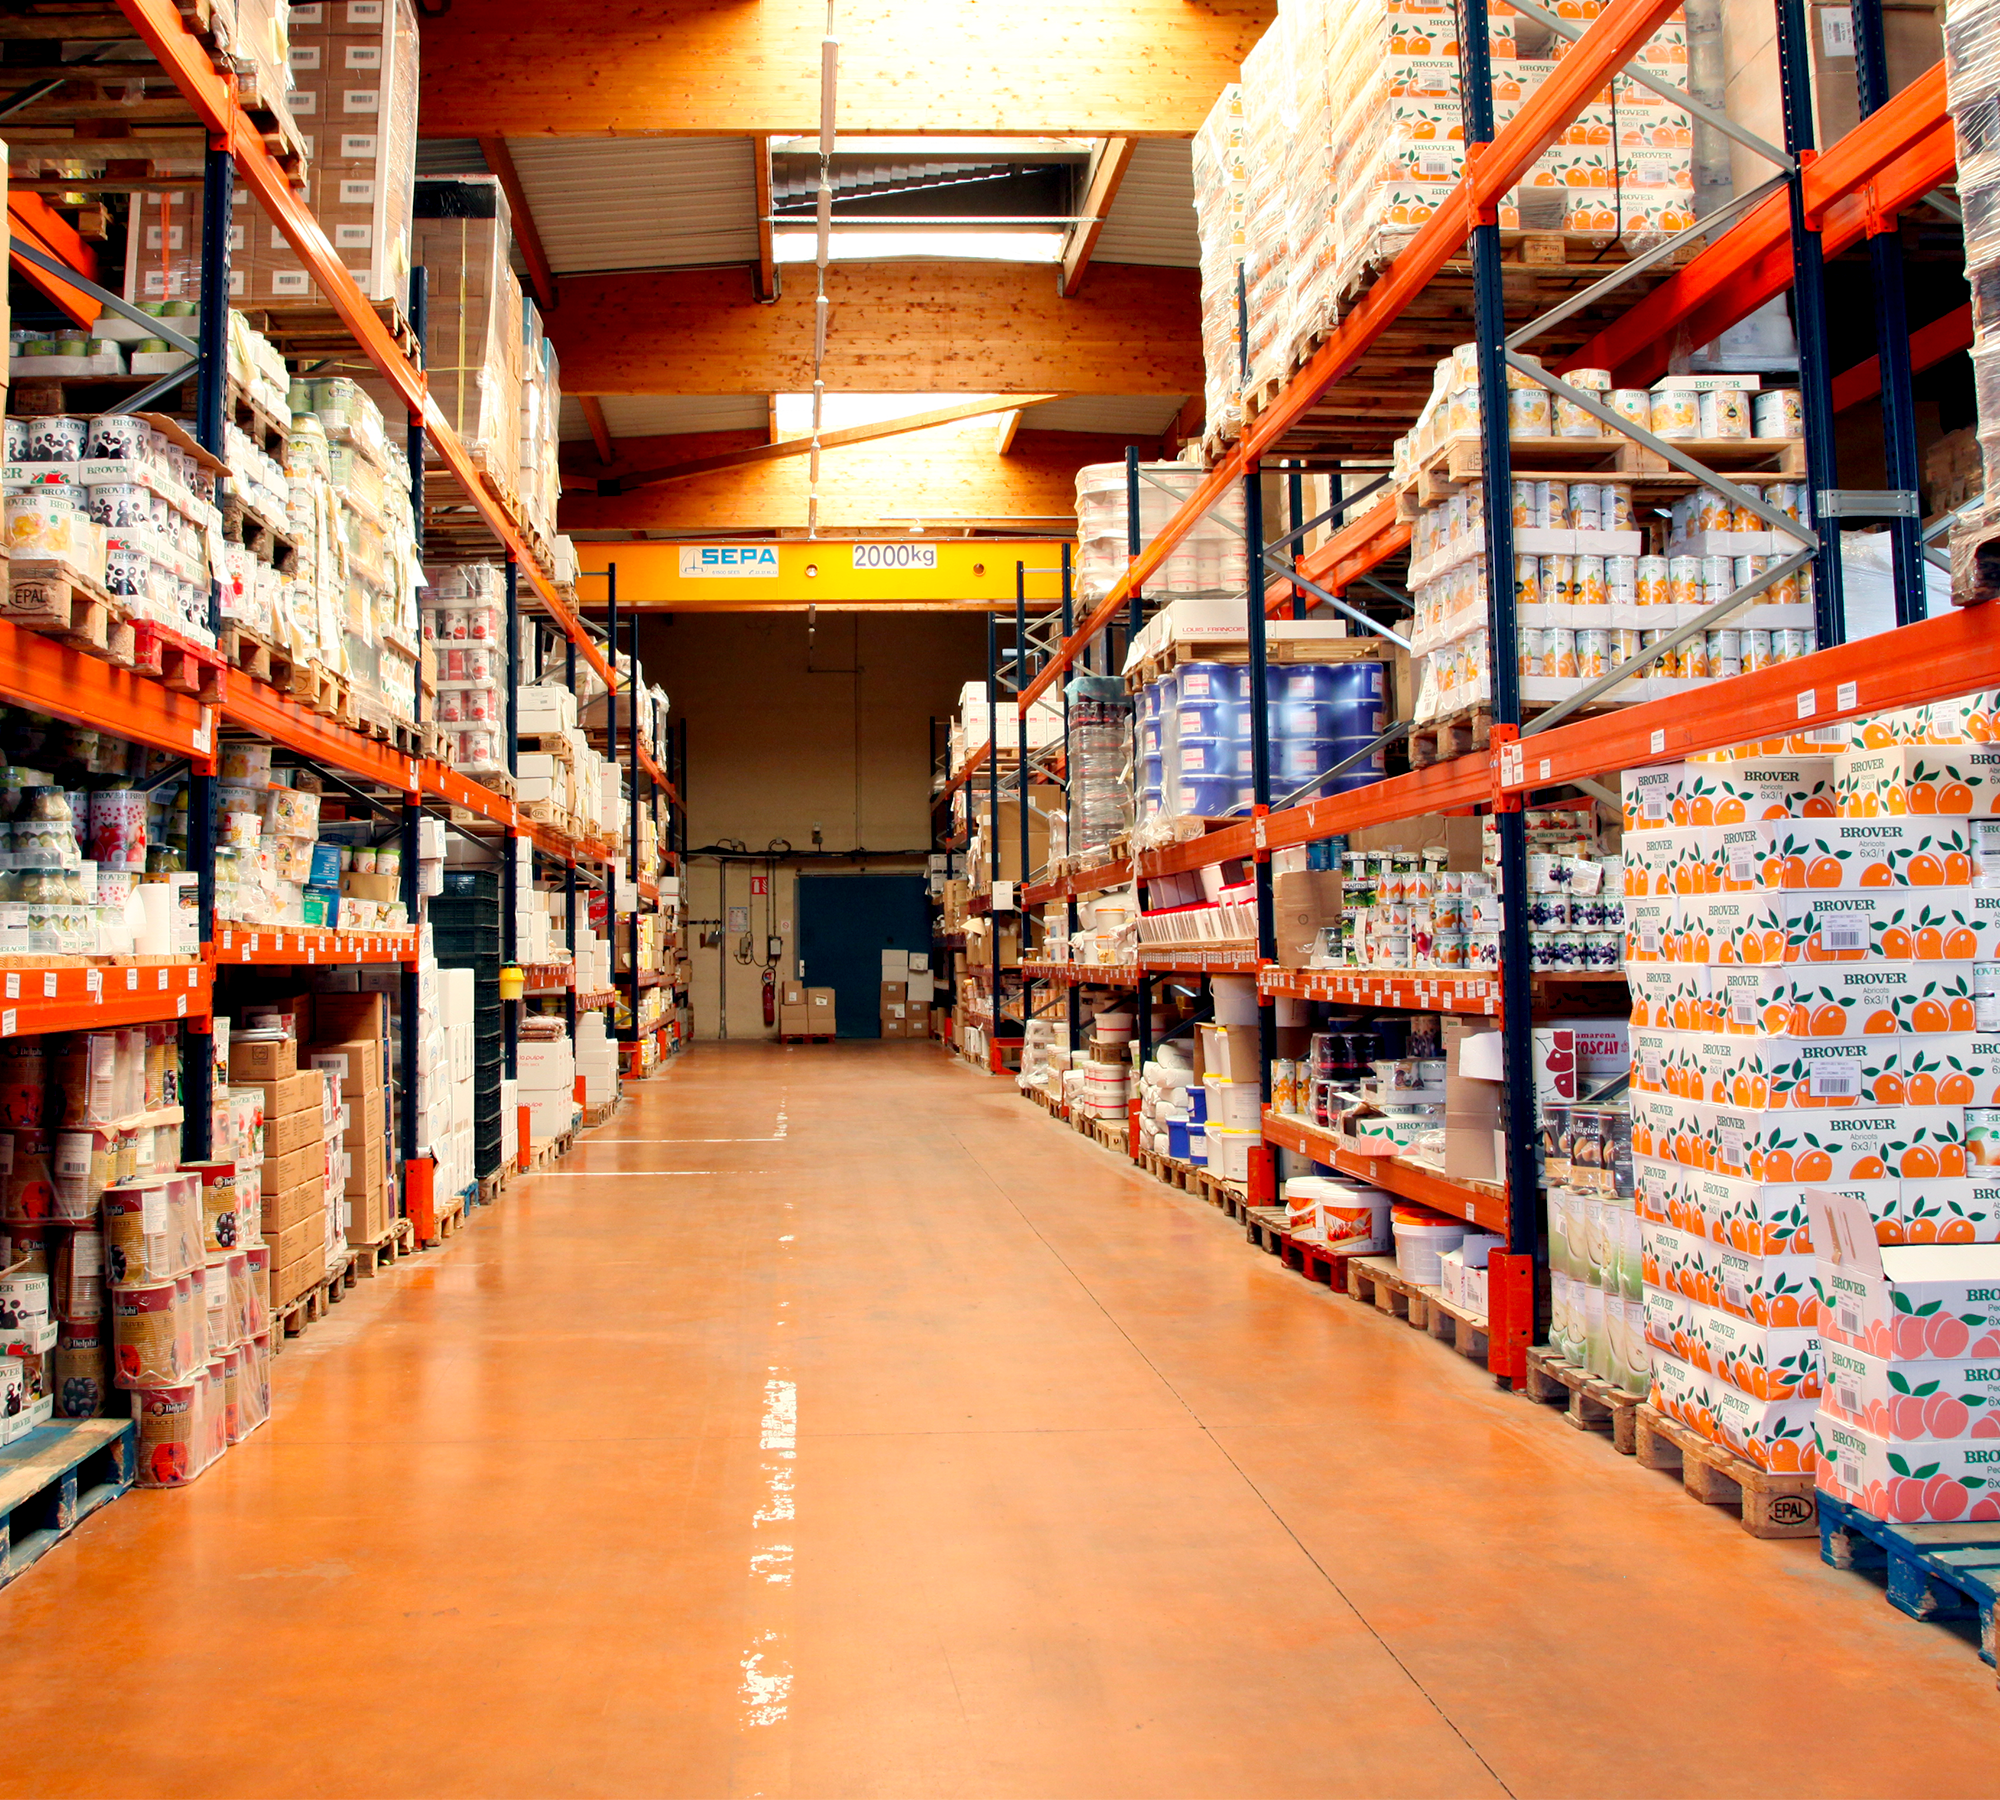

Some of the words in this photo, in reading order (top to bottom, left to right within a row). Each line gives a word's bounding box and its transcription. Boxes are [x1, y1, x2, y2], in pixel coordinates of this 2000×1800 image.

[96, 487, 136, 495] BROVER
[702, 549, 776, 564] SEPA
[855, 545, 934, 566] 2000kg
[15, 589, 46, 603] EPAL
[1851, 758, 1884, 773] BROVER
[1638, 773, 1669, 786] BROVER
[1744, 771, 1800, 781] BROVER
[1760, 791, 1783, 800] 6x3/1
[1724, 831, 1757, 844] BROVER
[1840, 826, 1903, 838] BROVER
[1646, 840, 1673, 850] BROVER
[1860, 849, 1885, 858] 6x3/1
[1636, 907, 1660, 916] BROVER
[1709, 905, 1739, 916] BROVER
[1813, 900, 1876, 912] BROVER
[1646, 972, 1671, 983] BROVER
[1727, 975, 1758, 986] BROVER
[1844, 973, 1908, 985] BROVER
[1864, 995, 1889, 1005] 6x3/1
[1639, 1037, 1663, 1048] BROVER
[1702, 1044, 1731, 1056] BROVER
[1802, 1045, 1868, 1059] BROVER
[1650, 1103, 1673, 1116] BROVER
[1716, 1116, 1745, 1129] BROVER
[1830, 1119, 1897, 1131] BROVER
[1851, 1141, 1878, 1151] 6x3/1
[1643, 1166, 1666, 1179] BROVER
[1703, 1182, 1729, 1198] BROVER
[1656, 1234, 1678, 1250] BROVER
[1722, 1253, 1749, 1272] BROVER
[1831, 1275, 1866, 1297] BROVER
[1650, 1294, 1673, 1311] BROVER
[1709, 1319, 1735, 1339] BROVER
[73, 1338, 97, 1347] Delphi
[1832, 1352, 1866, 1376] BROVER
[1663, 1362, 1686, 1382] BROVER
[165, 1403, 188, 1412] Delphi
[1723, 1393, 1749, 1415] BROVER
[1832, 1429, 1866, 1456] BROVER
[1775, 1503, 1806, 1518] EPAL
